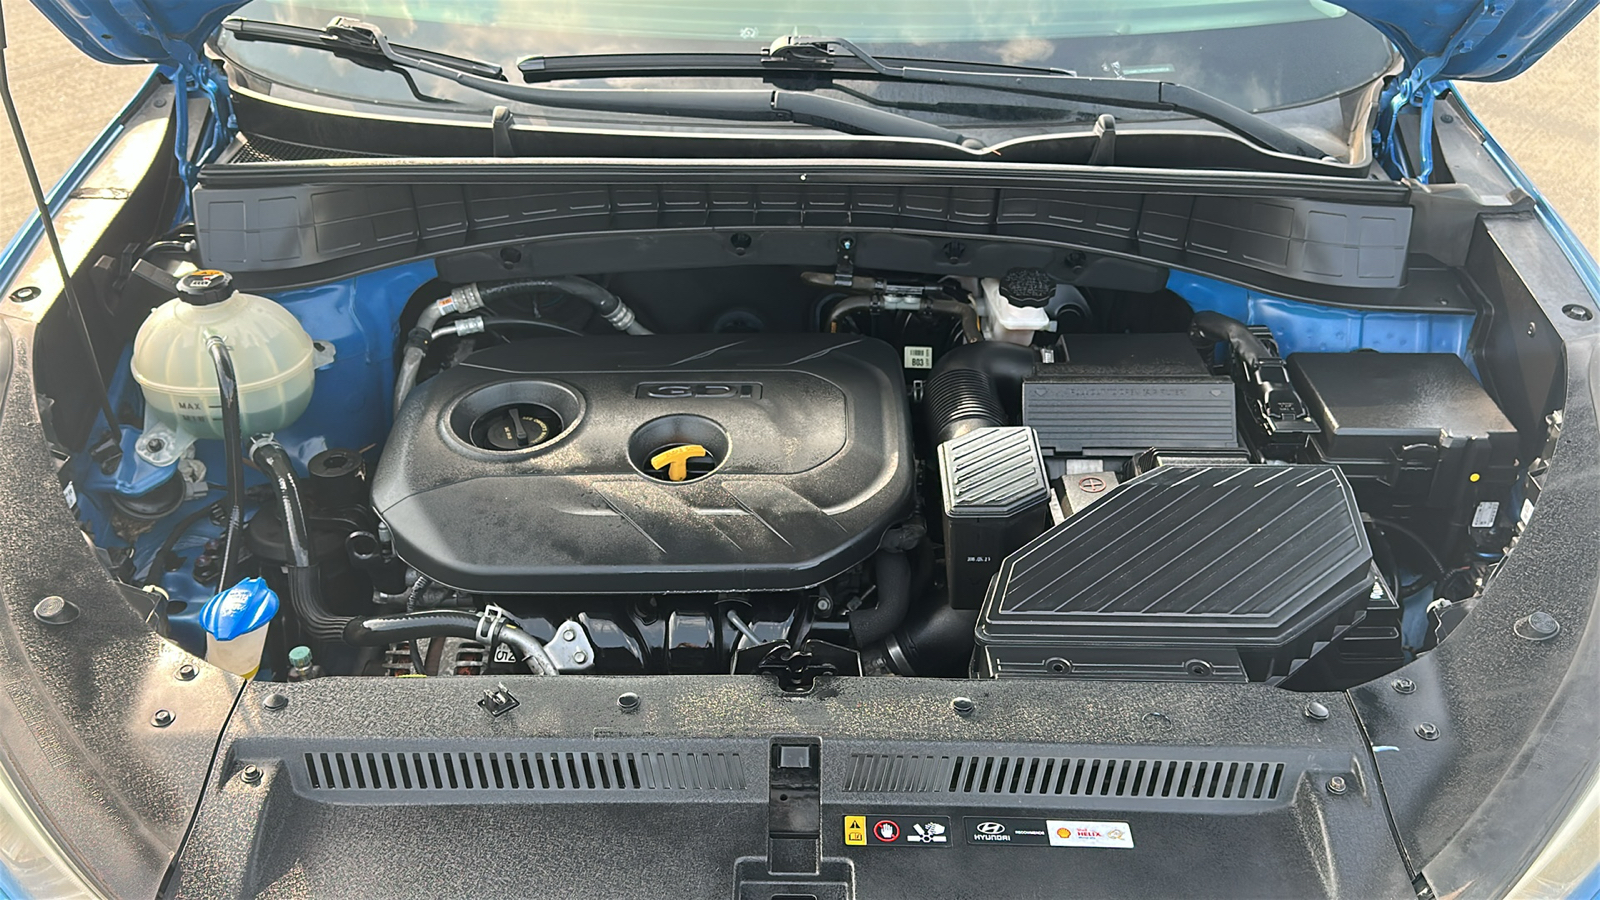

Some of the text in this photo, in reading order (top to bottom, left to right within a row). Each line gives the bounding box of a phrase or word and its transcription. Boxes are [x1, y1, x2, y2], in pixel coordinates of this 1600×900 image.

[648, 385, 752, 399] GDI
[178, 402, 201, 410] MAX
[973, 834, 1011, 842] HYUNDAI
